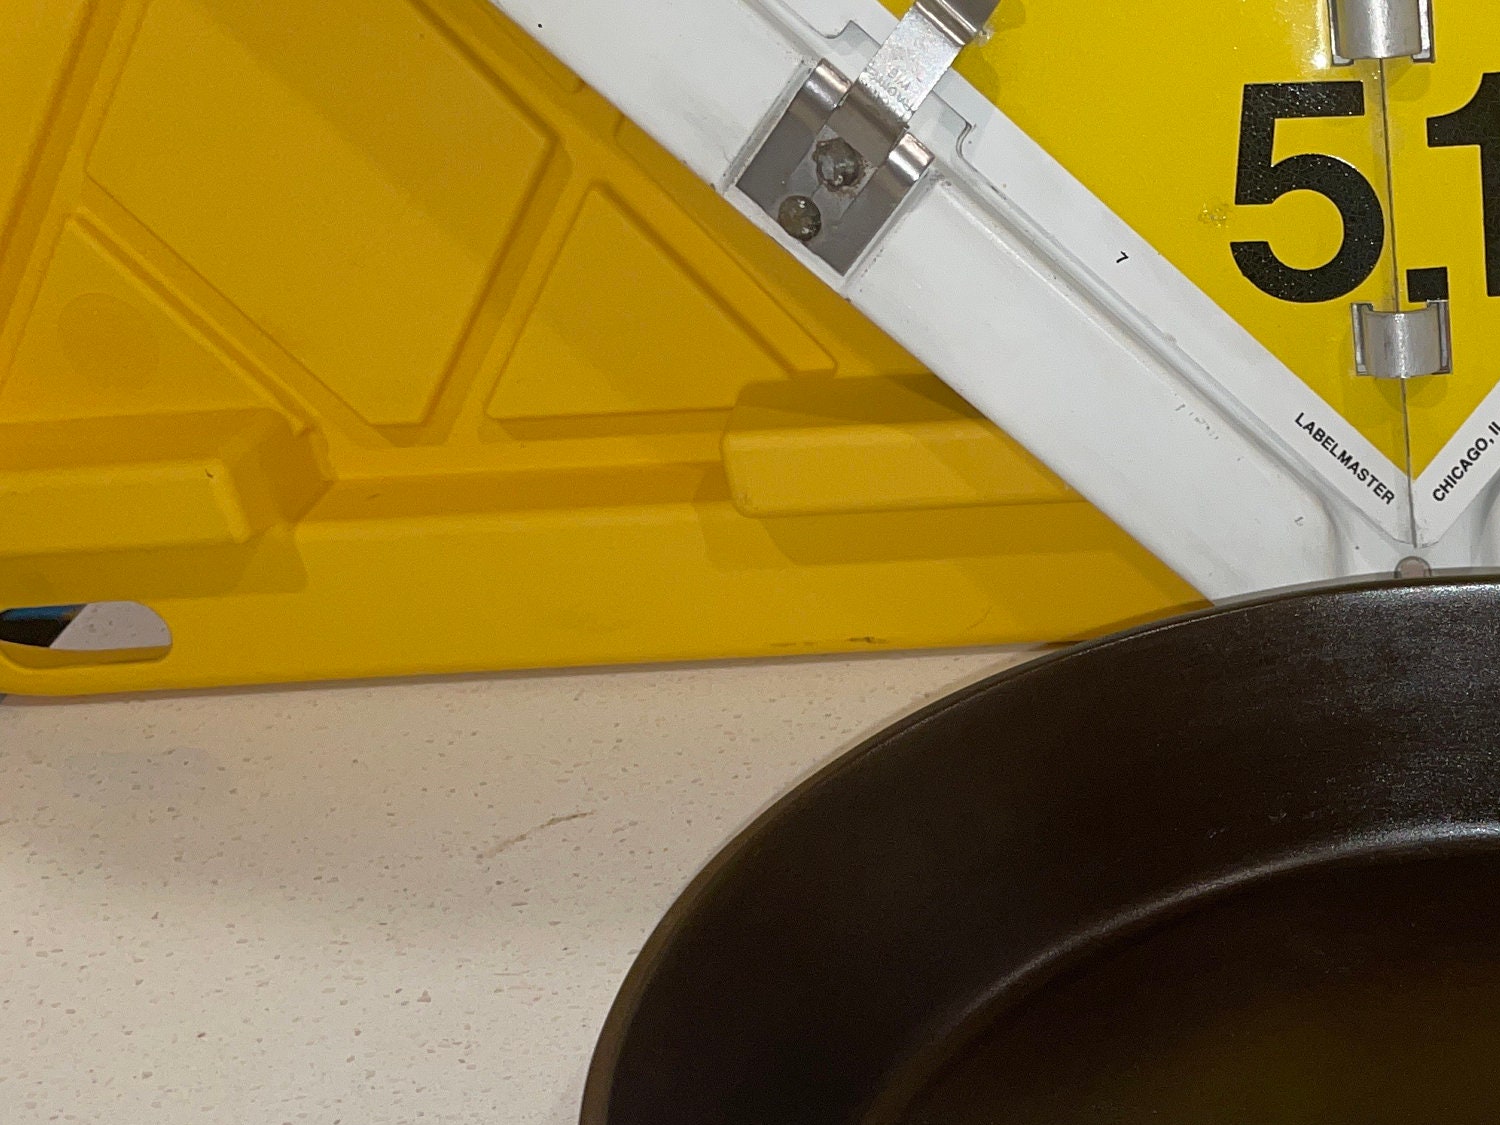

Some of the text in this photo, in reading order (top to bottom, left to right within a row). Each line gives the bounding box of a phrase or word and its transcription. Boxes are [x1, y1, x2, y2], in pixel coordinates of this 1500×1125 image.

[1116, 250, 1129, 264] 7
[1294, 412, 1395, 505] LABELMASTER
[1432, 437, 1495, 502] CHICAGO,
